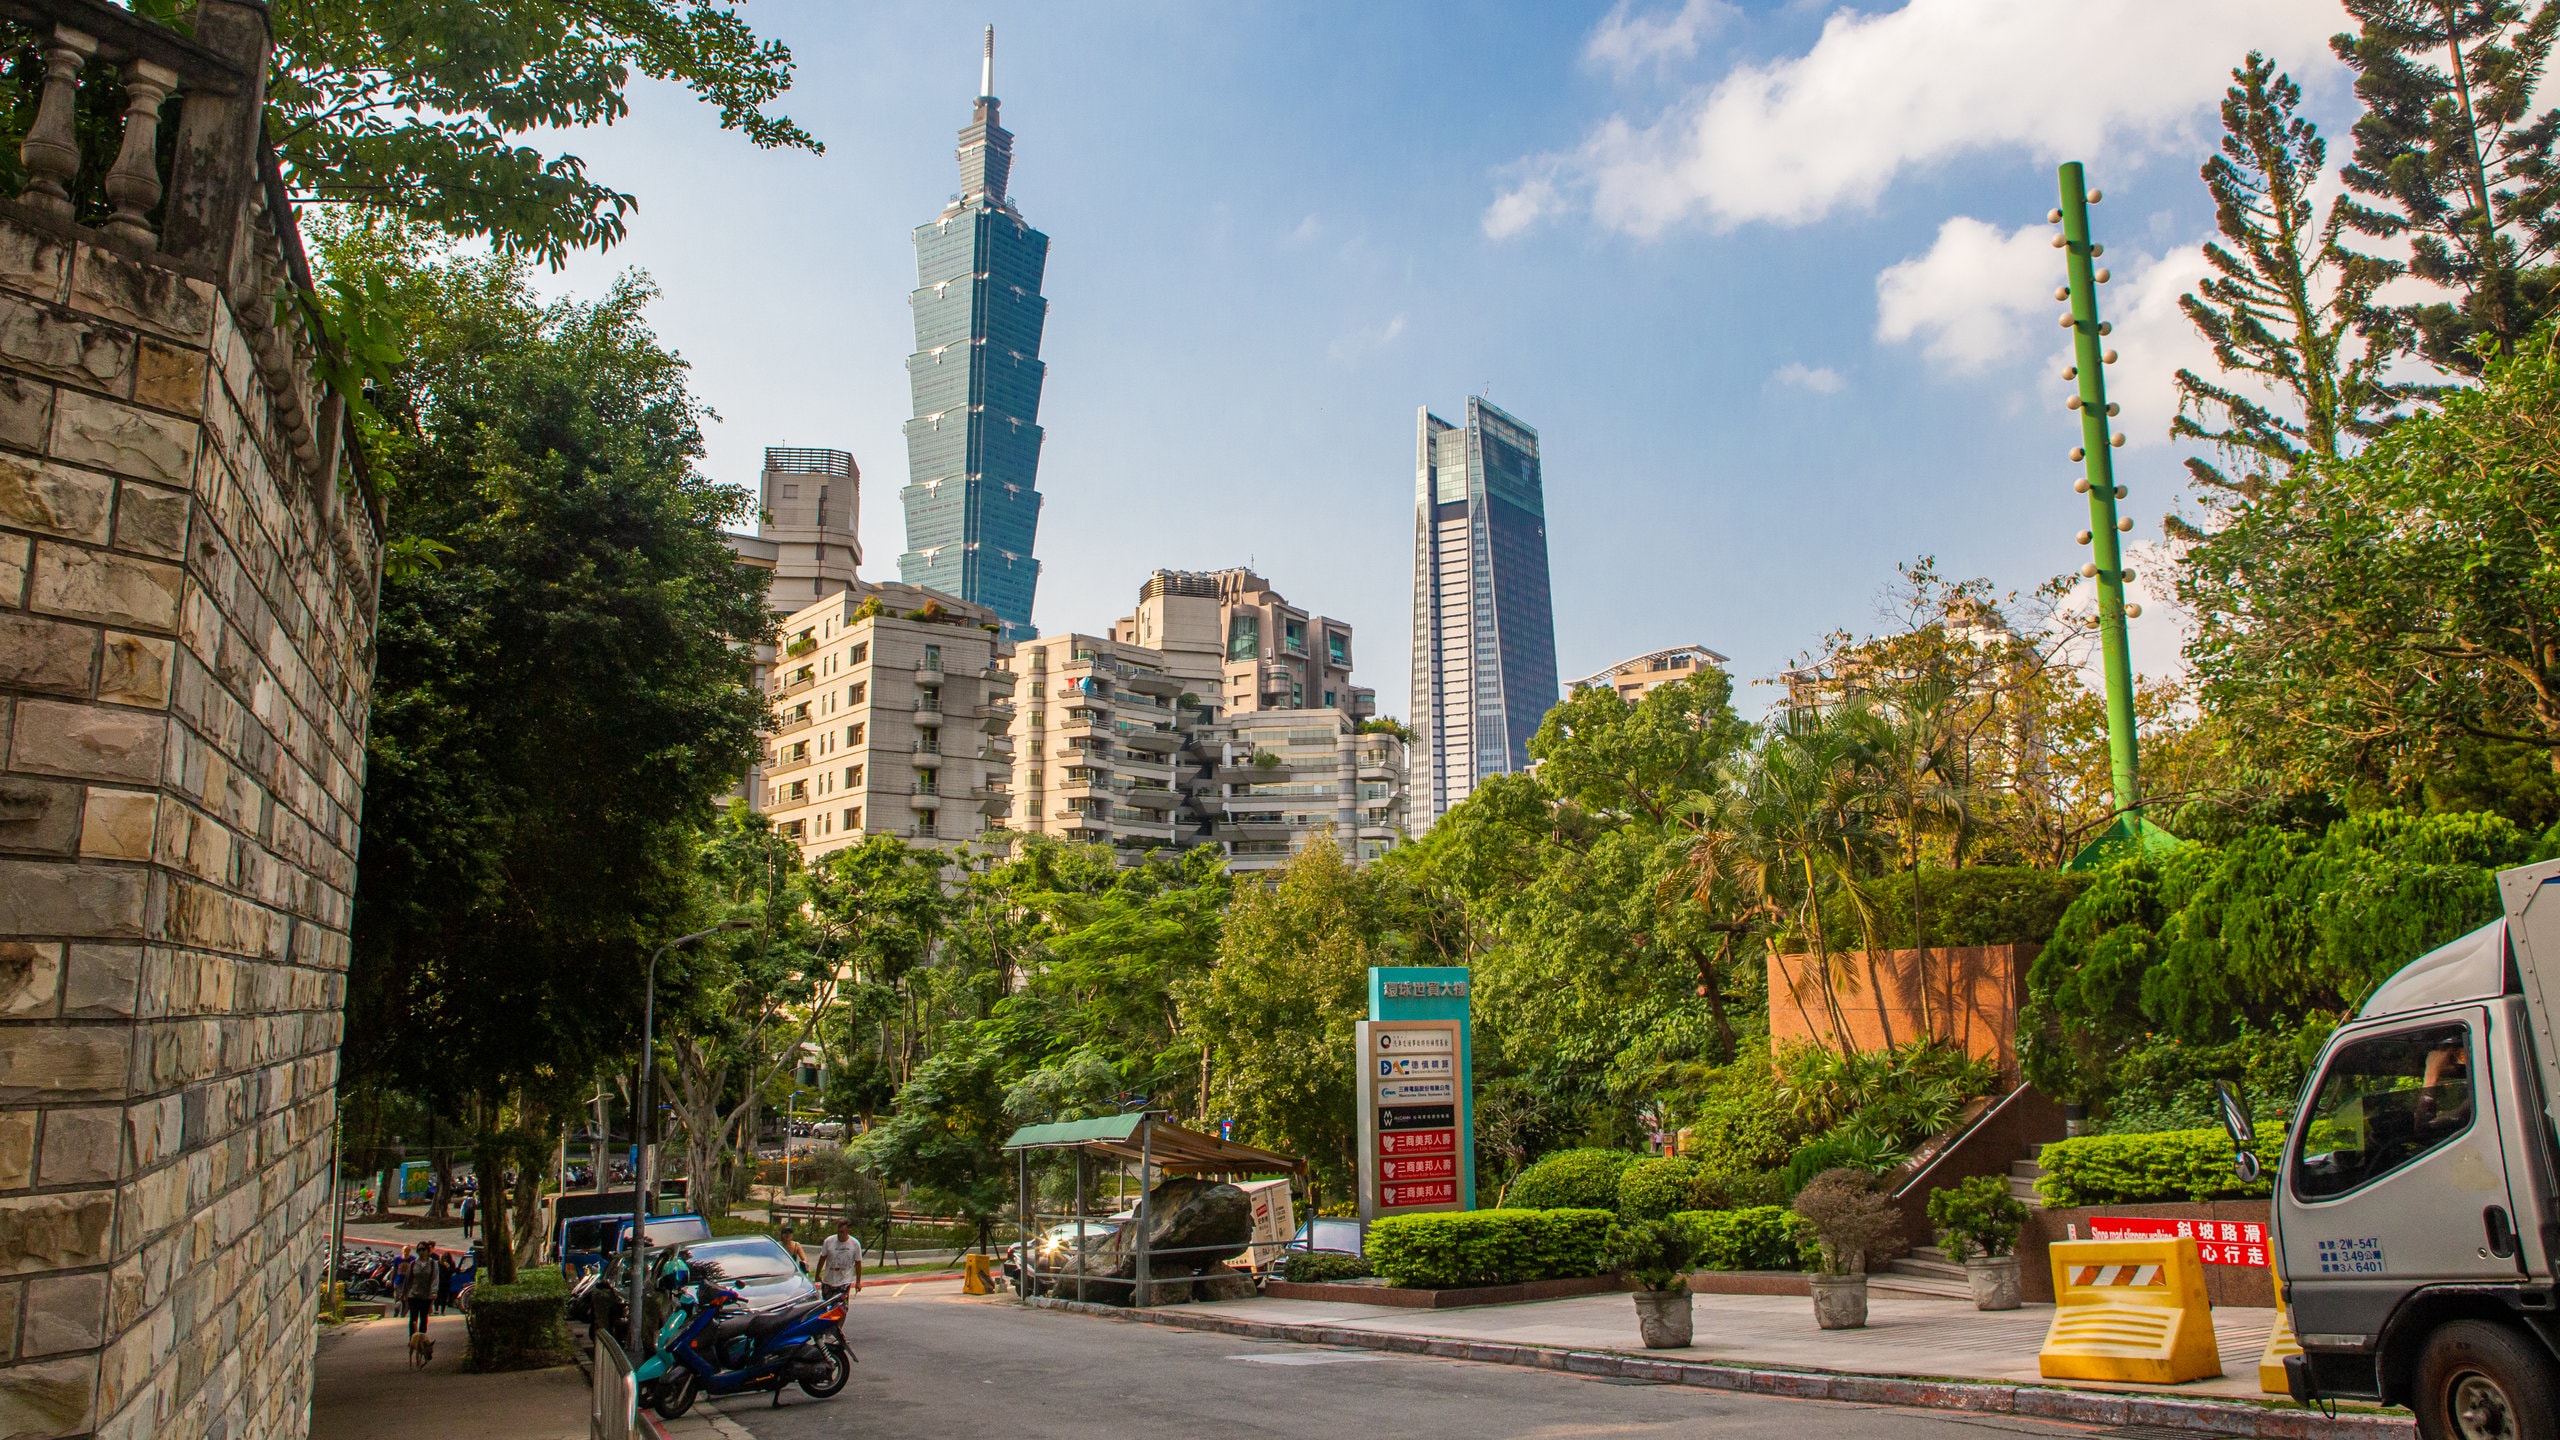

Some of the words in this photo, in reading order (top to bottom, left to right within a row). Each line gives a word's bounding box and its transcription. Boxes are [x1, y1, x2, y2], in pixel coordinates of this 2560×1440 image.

[1396, 1134, 1451, 1147] 三商美邦人壽
[1397, 1159, 1451, 1173] 三商美邦人壽
[1397, 1185, 1452, 1199] 三商美邦人壽
[2176, 1221, 2261, 1243] 斜坡路滑
